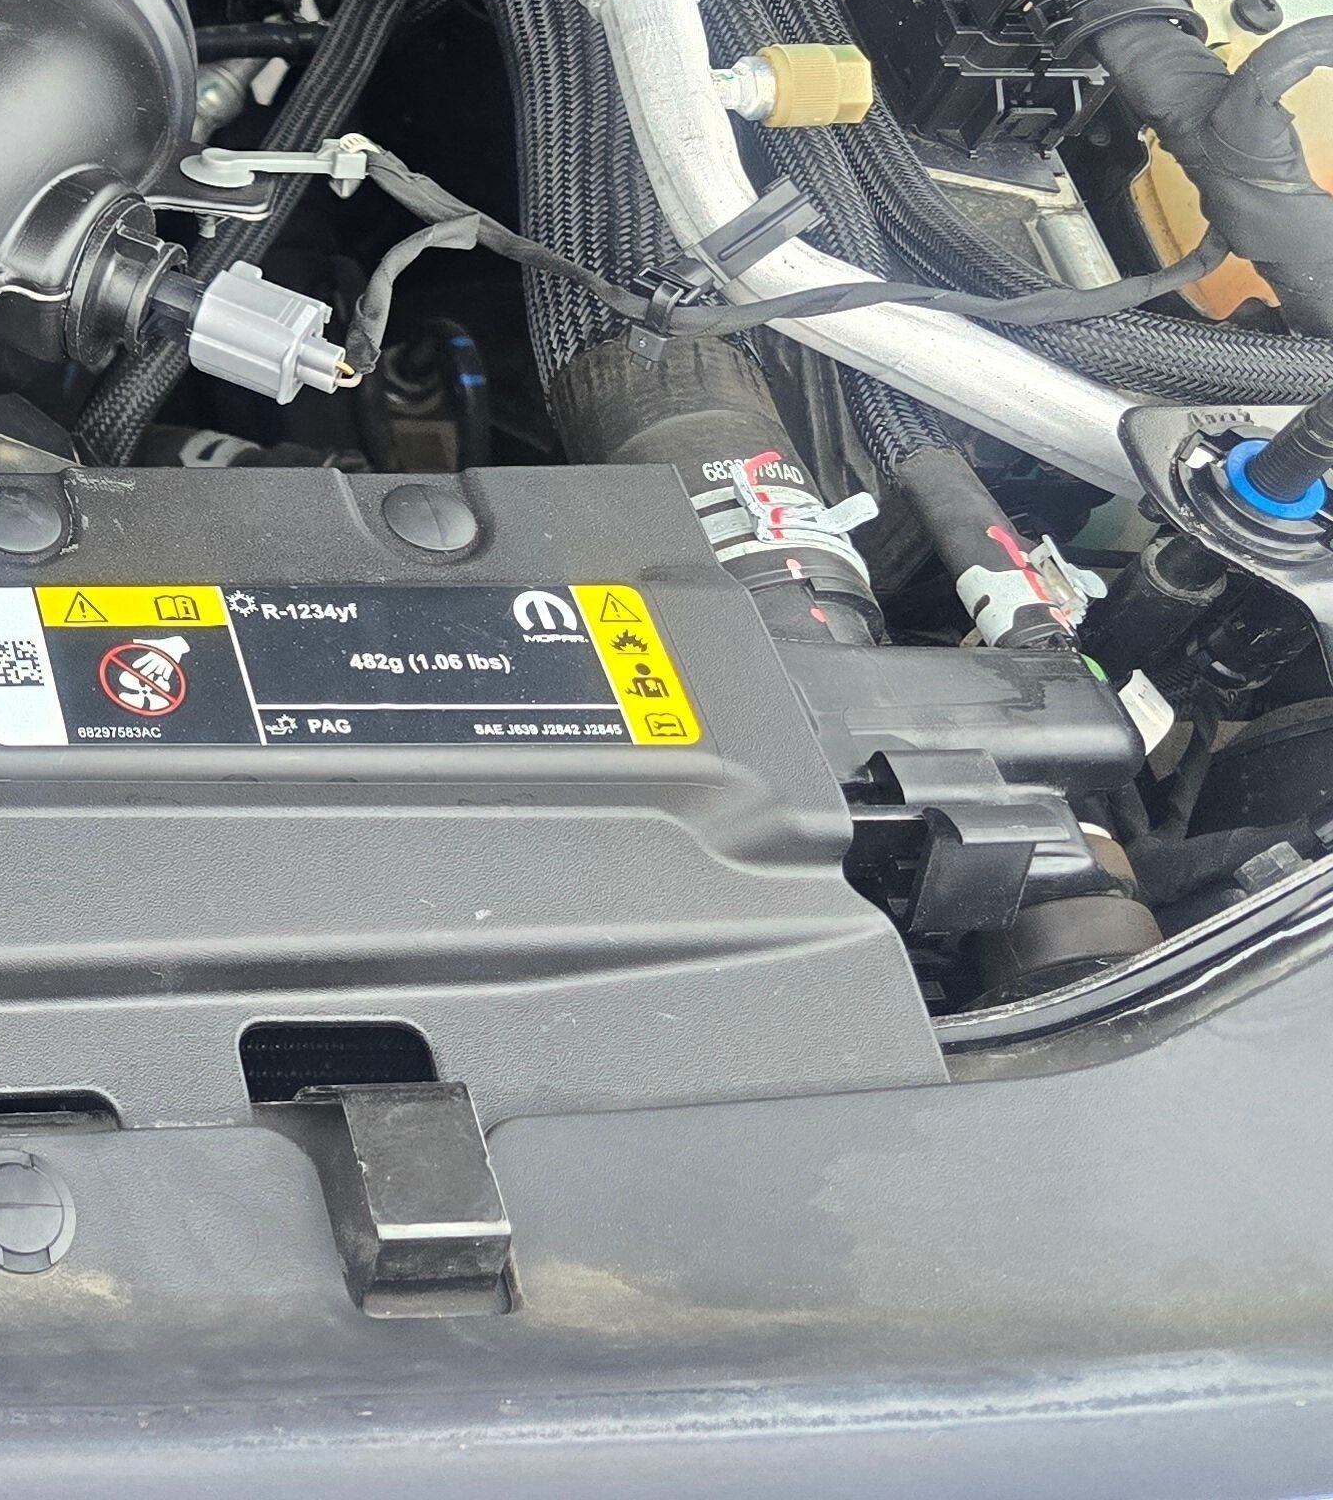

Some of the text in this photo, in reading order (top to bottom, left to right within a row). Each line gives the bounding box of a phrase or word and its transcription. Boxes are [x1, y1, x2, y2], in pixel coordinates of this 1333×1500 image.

[261, 602, 358, 623] R-1234yf
[350, 653, 511, 674] 482g (1.06 lbs)
[77, 726, 162, 739] 68297583AC
[307, 718, 352, 734] PAG
[473, 723, 505, 736] SAE
[542, 723, 581, 736] J2842
[583, 723, 623, 736] J2845
